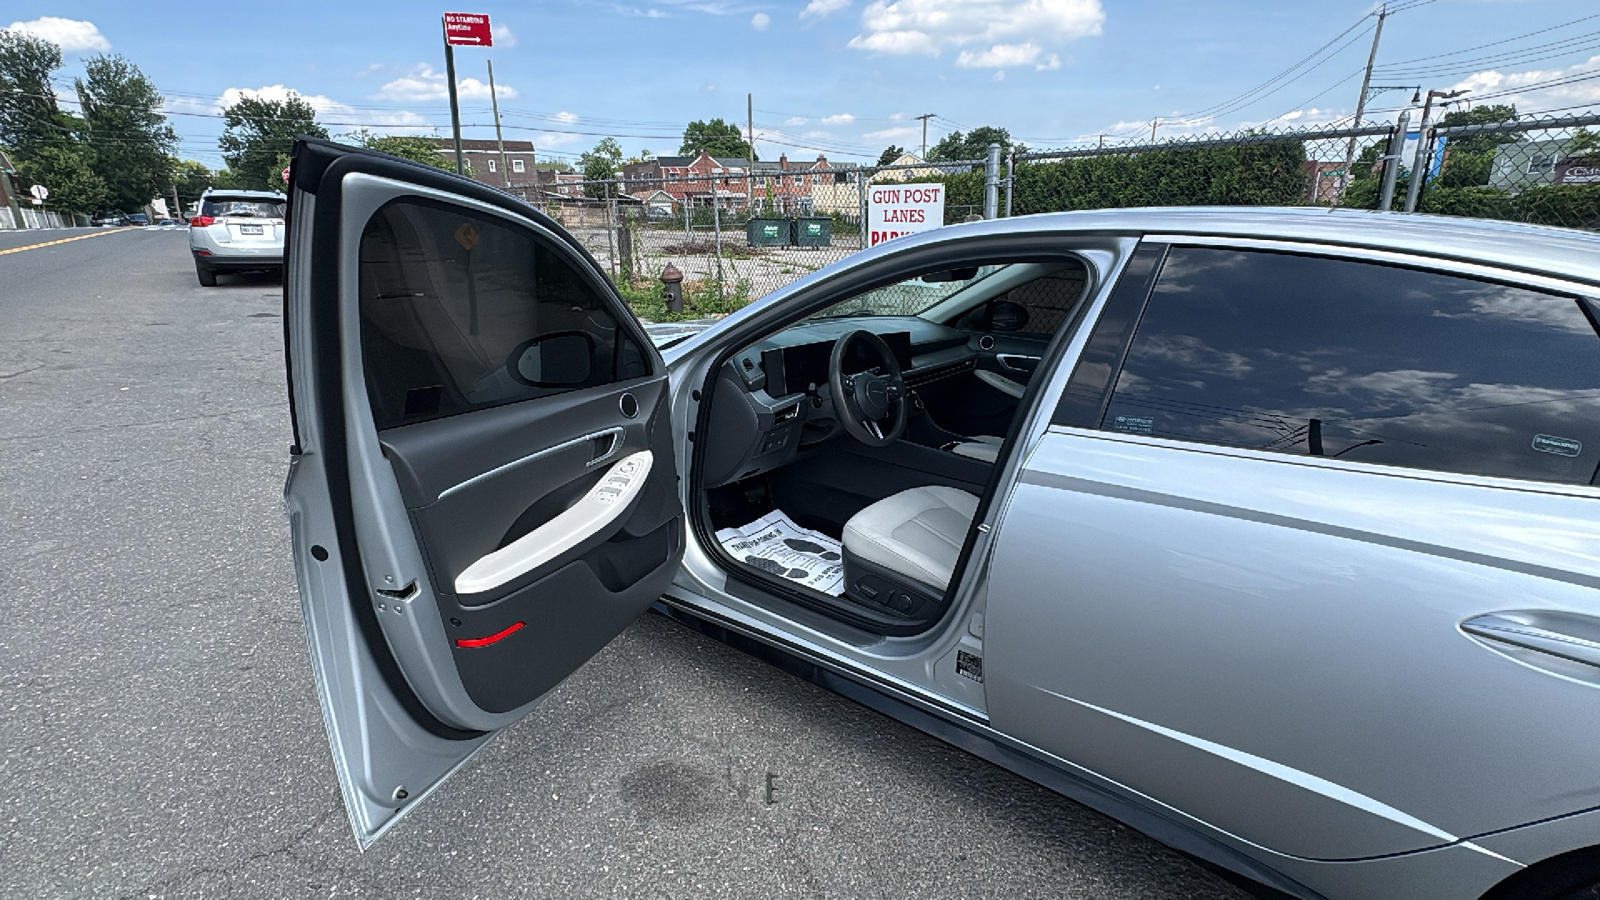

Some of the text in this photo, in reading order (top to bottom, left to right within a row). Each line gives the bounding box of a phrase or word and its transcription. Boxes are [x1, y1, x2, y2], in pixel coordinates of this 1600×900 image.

[446, 15, 484, 24] NO STANDING
[447, 23, 472, 32] Anytime
[872, 188, 941, 204] GUN POST
[883, 209, 926, 223] LANES
